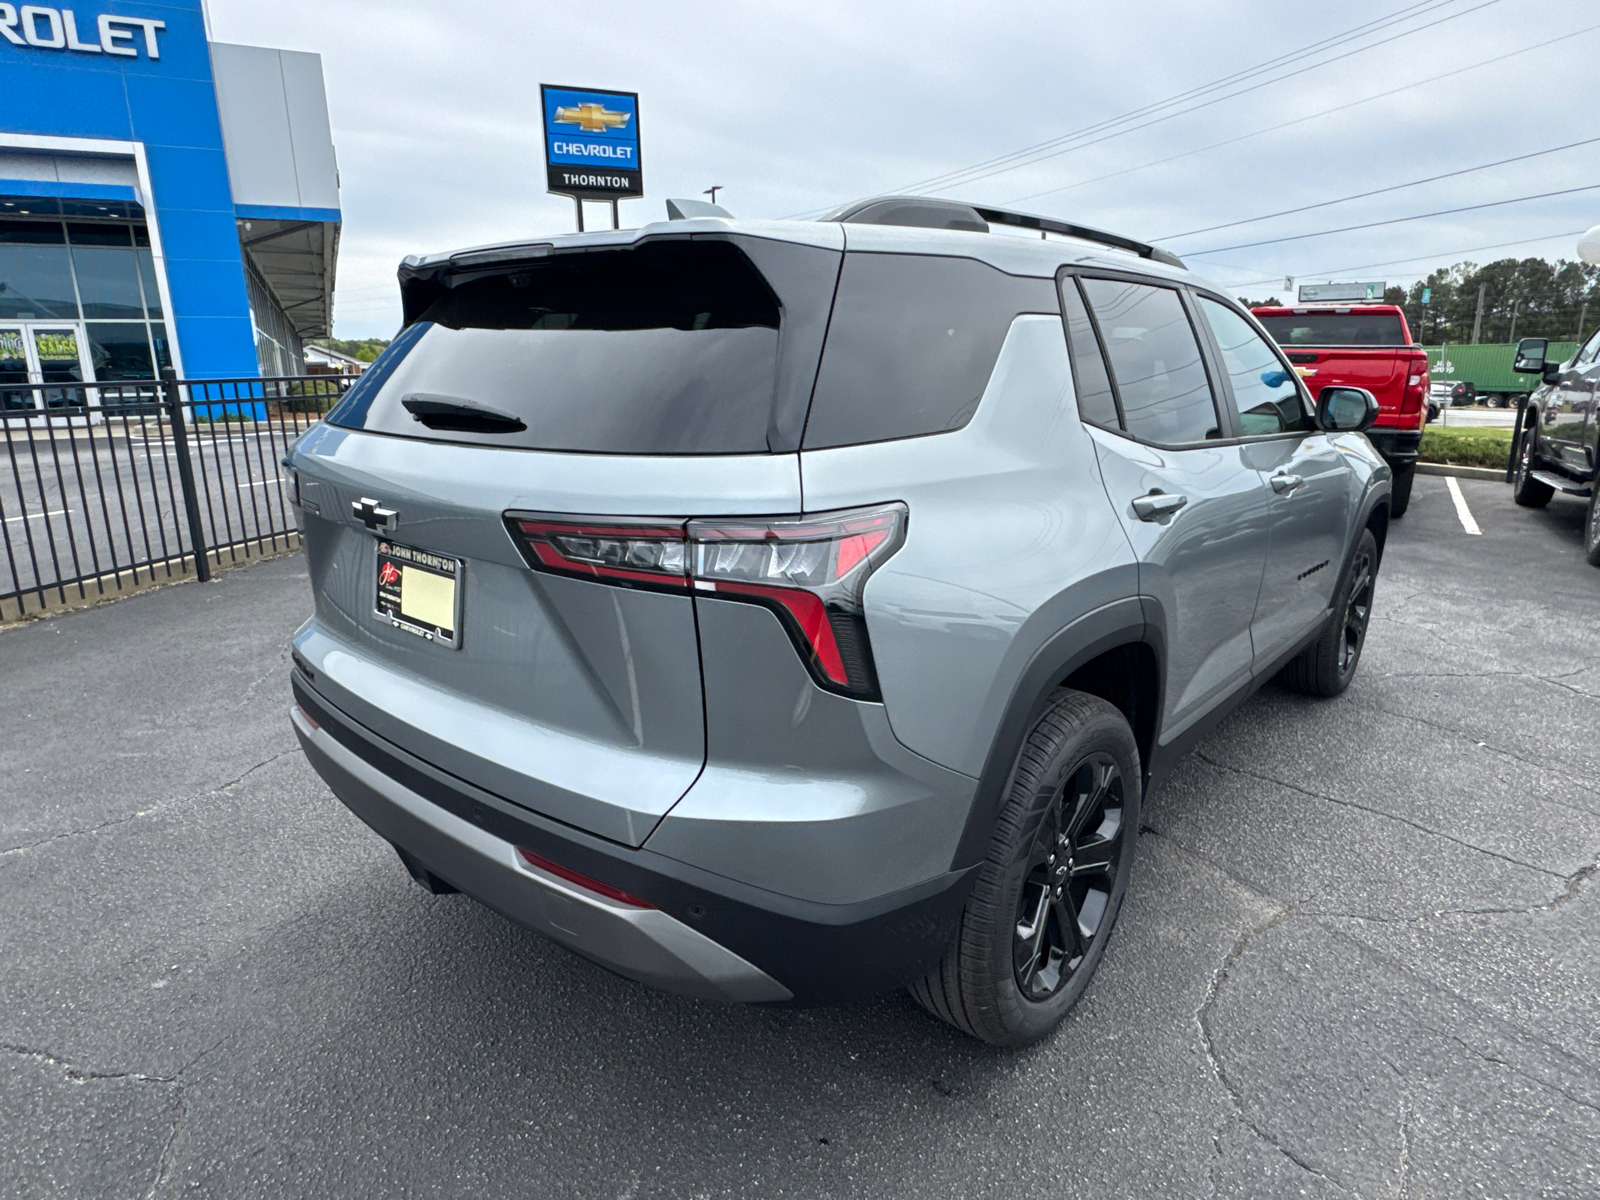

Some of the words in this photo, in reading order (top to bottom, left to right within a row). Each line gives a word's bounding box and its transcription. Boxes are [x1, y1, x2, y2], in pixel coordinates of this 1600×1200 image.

[554, 142, 632, 159] CHEVROLET
[563, 174, 629, 188] THORNTON
[39, 340, 77, 354] SALES
[392, 545, 412, 559] JOHN
[412, 551, 454, 571] THORNTON
